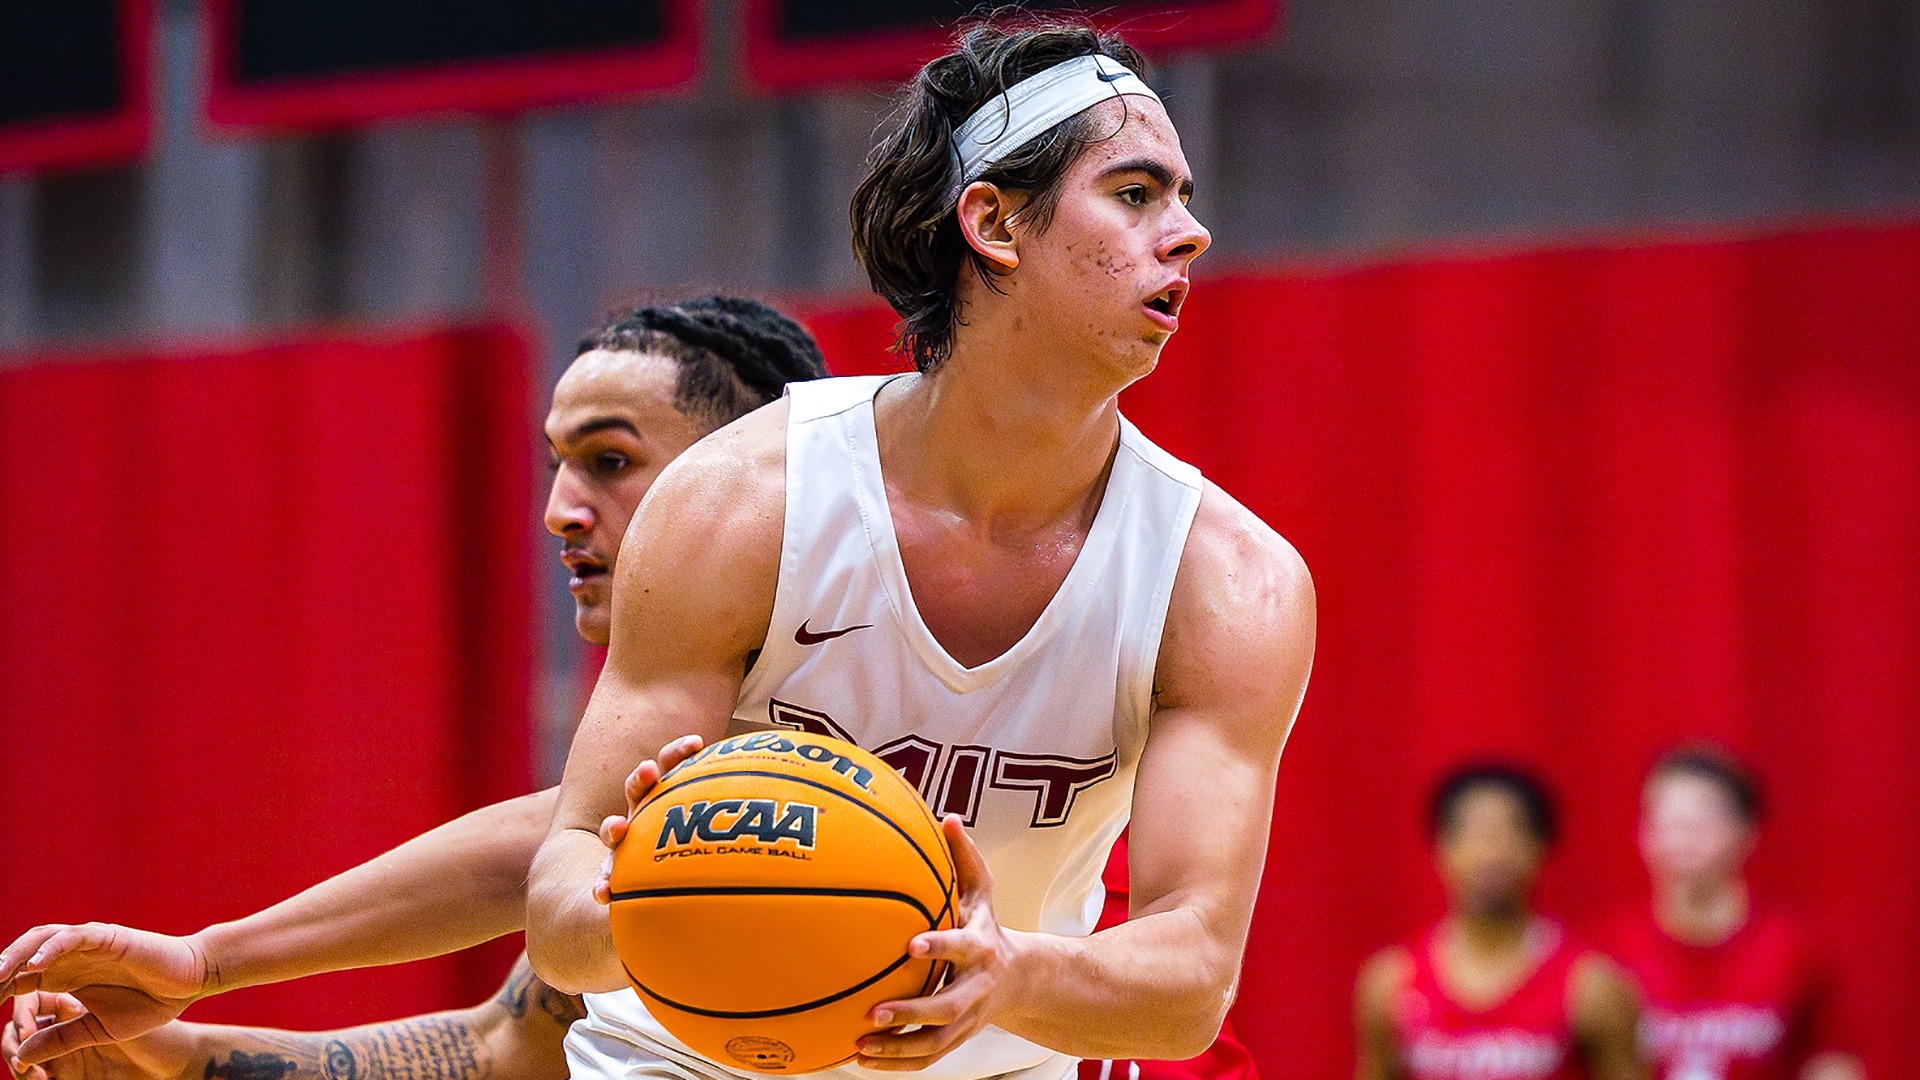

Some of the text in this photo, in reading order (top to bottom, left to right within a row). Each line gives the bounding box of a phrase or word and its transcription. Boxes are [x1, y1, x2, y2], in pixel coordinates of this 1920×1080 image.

[655, 800, 816, 850] NCAA
[716, 846, 762, 855] GAME
[768, 848, 812, 860] BALL
